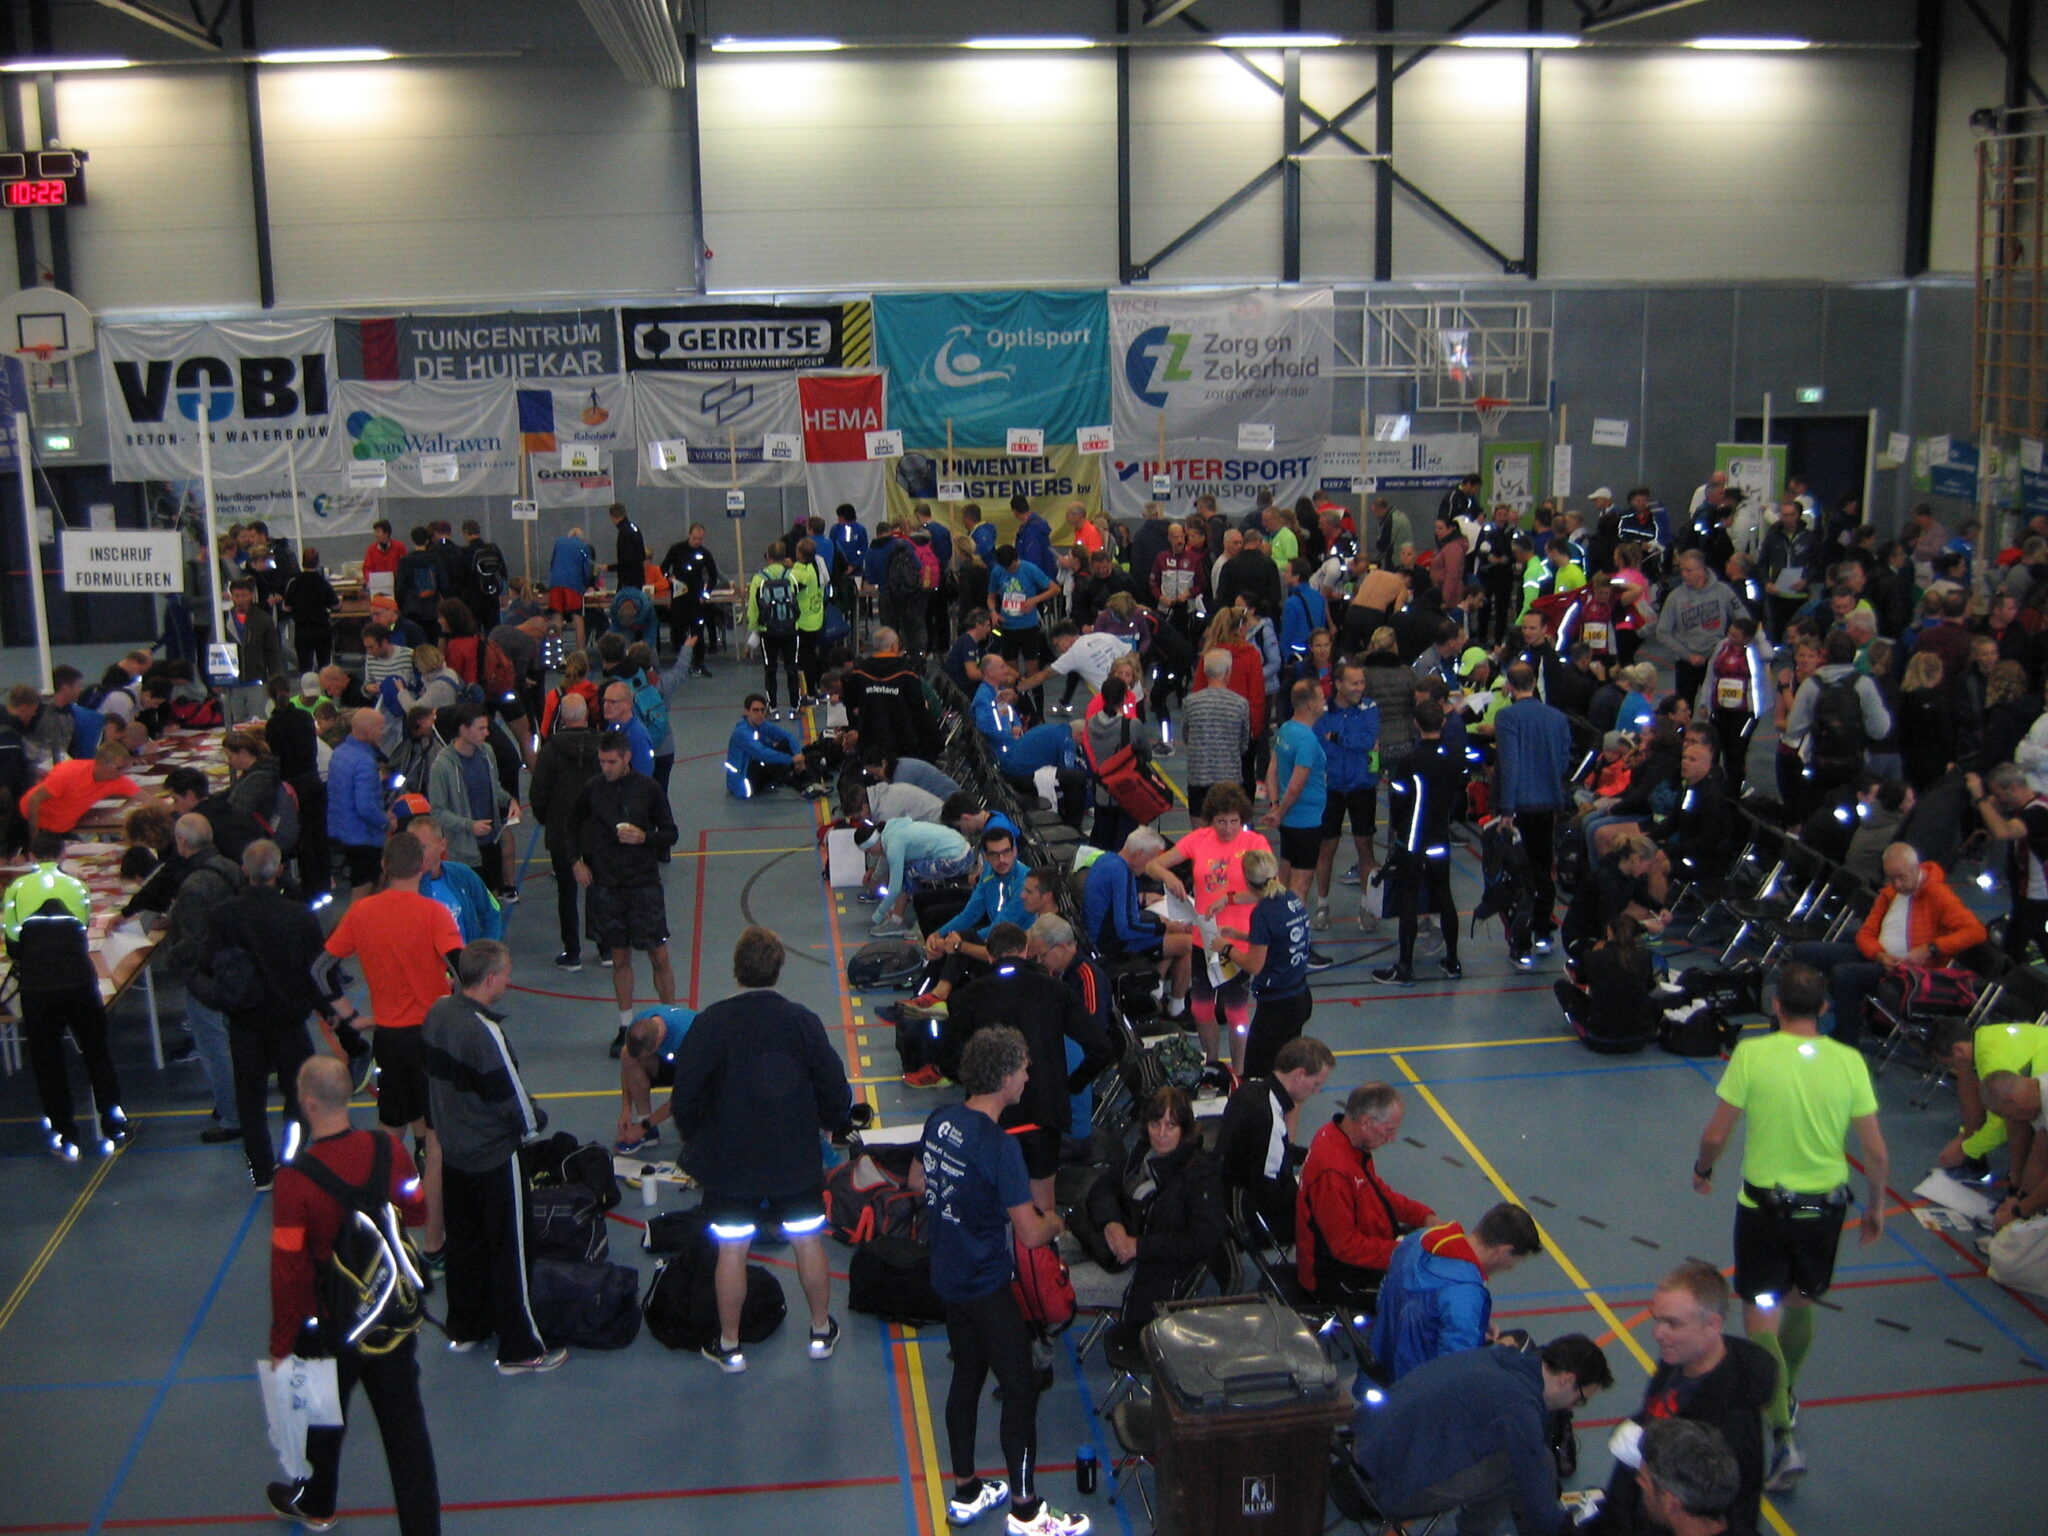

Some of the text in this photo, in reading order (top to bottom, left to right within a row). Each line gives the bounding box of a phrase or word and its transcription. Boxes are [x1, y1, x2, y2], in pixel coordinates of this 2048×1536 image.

[10, 181, 64, 204] 10:22
[412, 324, 601, 350] TUINCENTRUM
[679, 327, 821, 350] GERRITSE
[987, 327, 1090, 350] Optisport
[1204, 333, 1291, 357] Zorg en
[415, 351, 604, 381] DE HUIFKAR
[687, 360, 718, 370] ISERO
[1204, 356, 1319, 381] Zekerheid
[114, 353, 328, 422] VOBI
[1204, 386, 1310, 401] zorgverzekeraar
[804, 408, 878, 431] HEMA
[226, 426, 329, 442] WATERBOUW
[402, 432, 502, 454] Walraven
[574, 430, 617, 441] Rabobank
[942, 456, 1055, 476] PIMENTEL
[1143, 457, 1313, 481] INTERSPORT
[963, 478, 1073, 499] ASTENERS
[217, 505, 241, 513] recht
[90, 547, 153, 562] INSCHRIJF
[76, 571, 172, 587] FORMULIEREN
